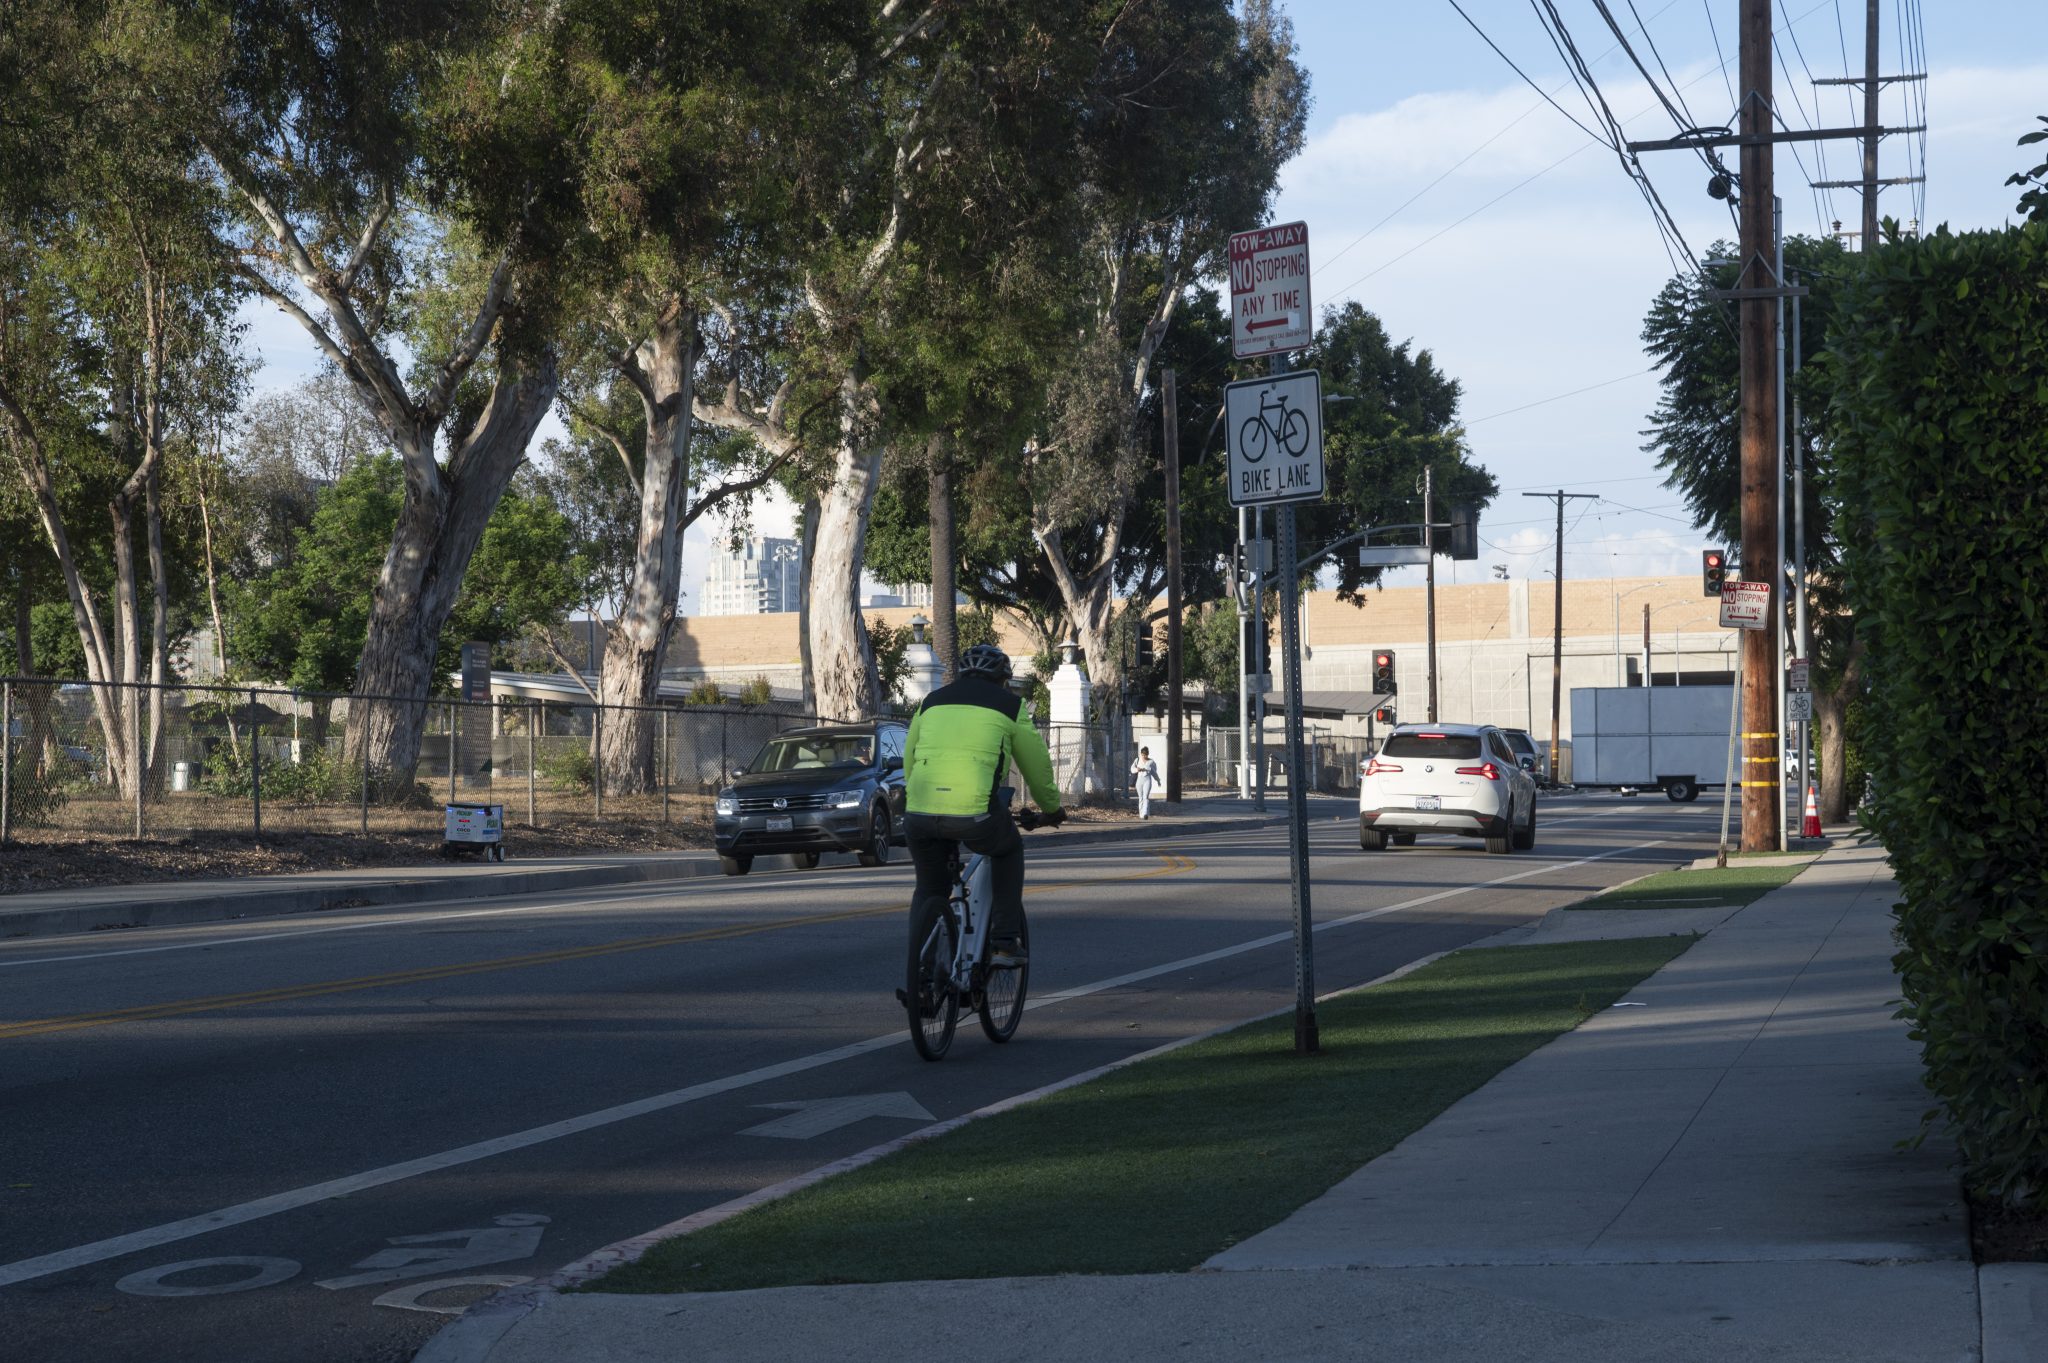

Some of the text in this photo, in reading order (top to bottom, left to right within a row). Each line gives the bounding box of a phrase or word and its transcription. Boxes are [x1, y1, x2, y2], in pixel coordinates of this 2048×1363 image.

[1232, 226, 1304, 254] TOW-AWAY
[1232, 253, 1305, 291] NO STOPPING
[1242, 290, 1300, 317] ANY TIME
[1242, 463, 1311, 493] BIKE LANE
[1723, 590, 1766, 604] NO STOPPING
[1725, 583, 1767, 591] TOW-AWAY
[1727, 605, 1761, 615] ANY TIME
